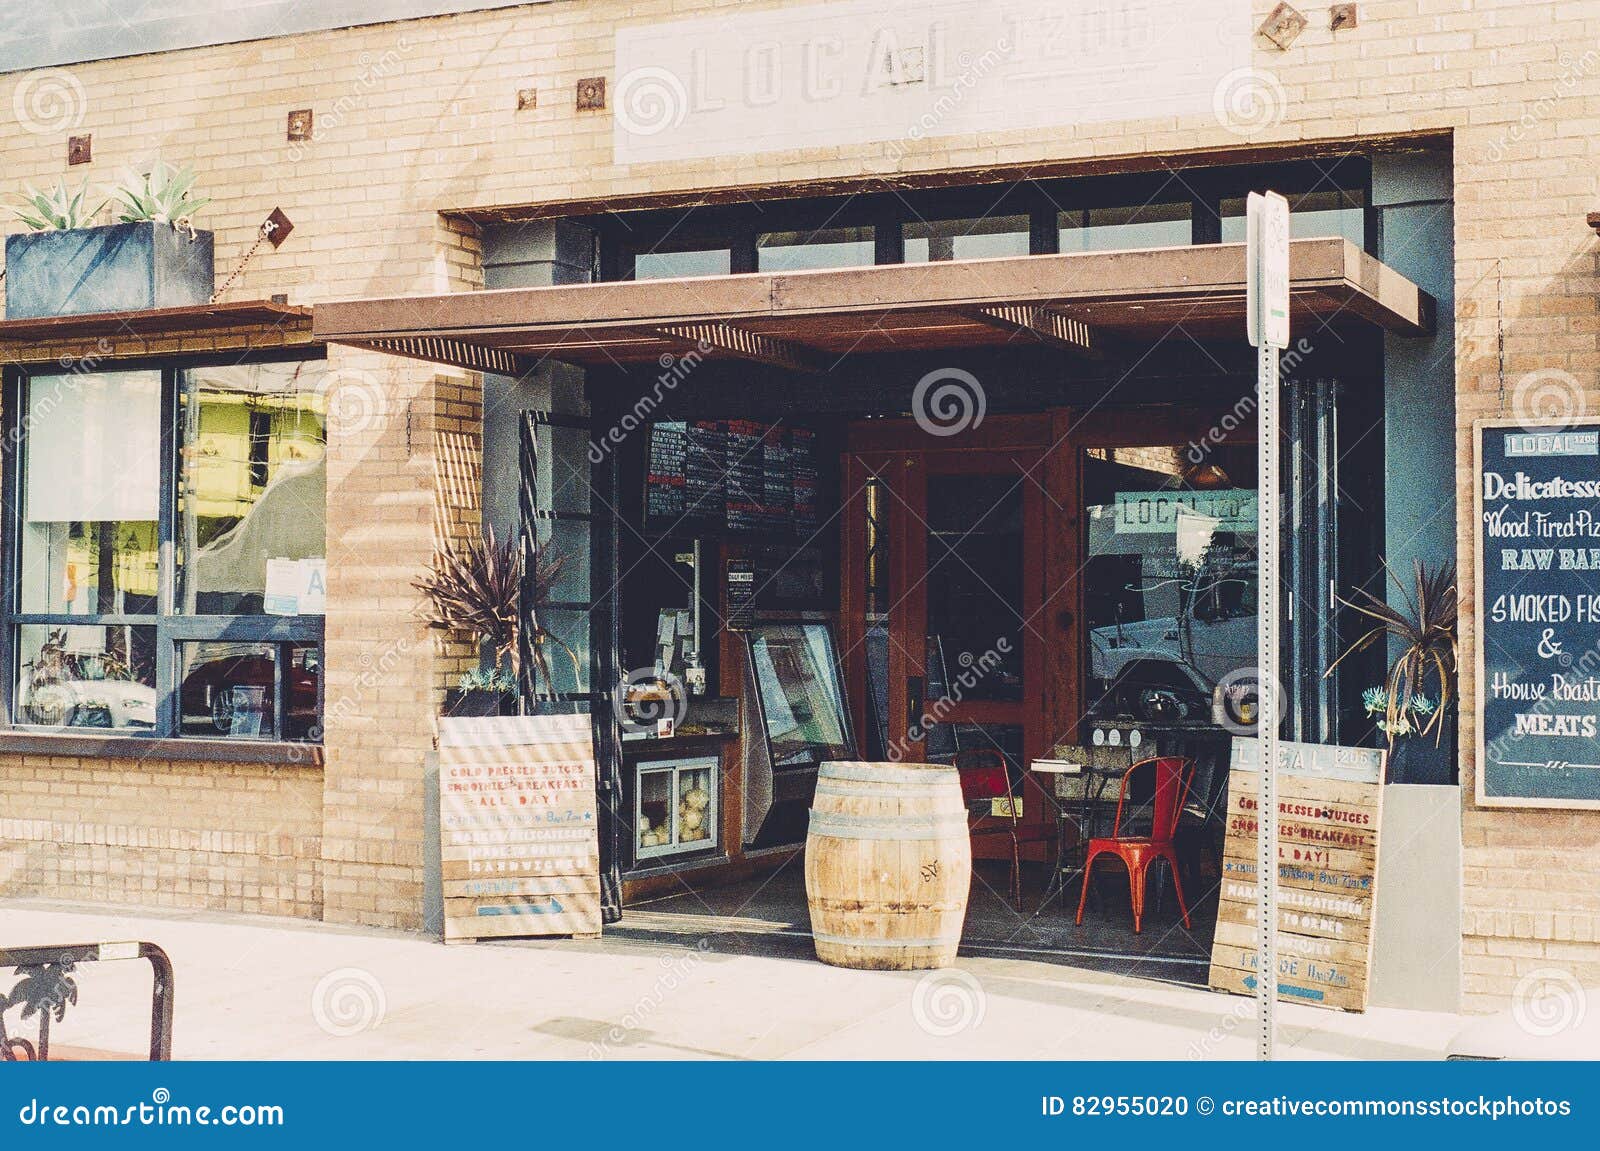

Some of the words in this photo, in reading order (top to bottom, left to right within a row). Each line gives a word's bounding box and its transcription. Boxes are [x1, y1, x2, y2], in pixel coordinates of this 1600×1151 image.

[690, 20, 955, 114] LOCAL
[1511, 435, 1574, 453] LOCAL
[1484, 504, 1531, 538] Wood
[1532, 511, 1577, 538] Fired
[1501, 548, 1554, 570] RAW
[1559, 548, 1600, 570] BAR
[307, 570, 325, 595] A
[1491, 594, 1571, 622] SMOKED
[1537, 628, 1562, 659] &
[1491, 672, 1546, 700] House
[1552, 673, 1600, 701] Roast
[1515, 713, 1597, 738] MEATS
[1238, 742, 1323, 771] LCAL
[450, 766, 482, 777] COLD
[1277, 802, 1321, 818] RESSED
[1327, 808, 1369, 825] JUICES
[1301, 830, 1365, 846] BREAKFAST
[1294, 848, 1330, 863] DAY!
[1302, 917, 1343, 934] ORDER
[1240, 953, 1298, 976] INDE
